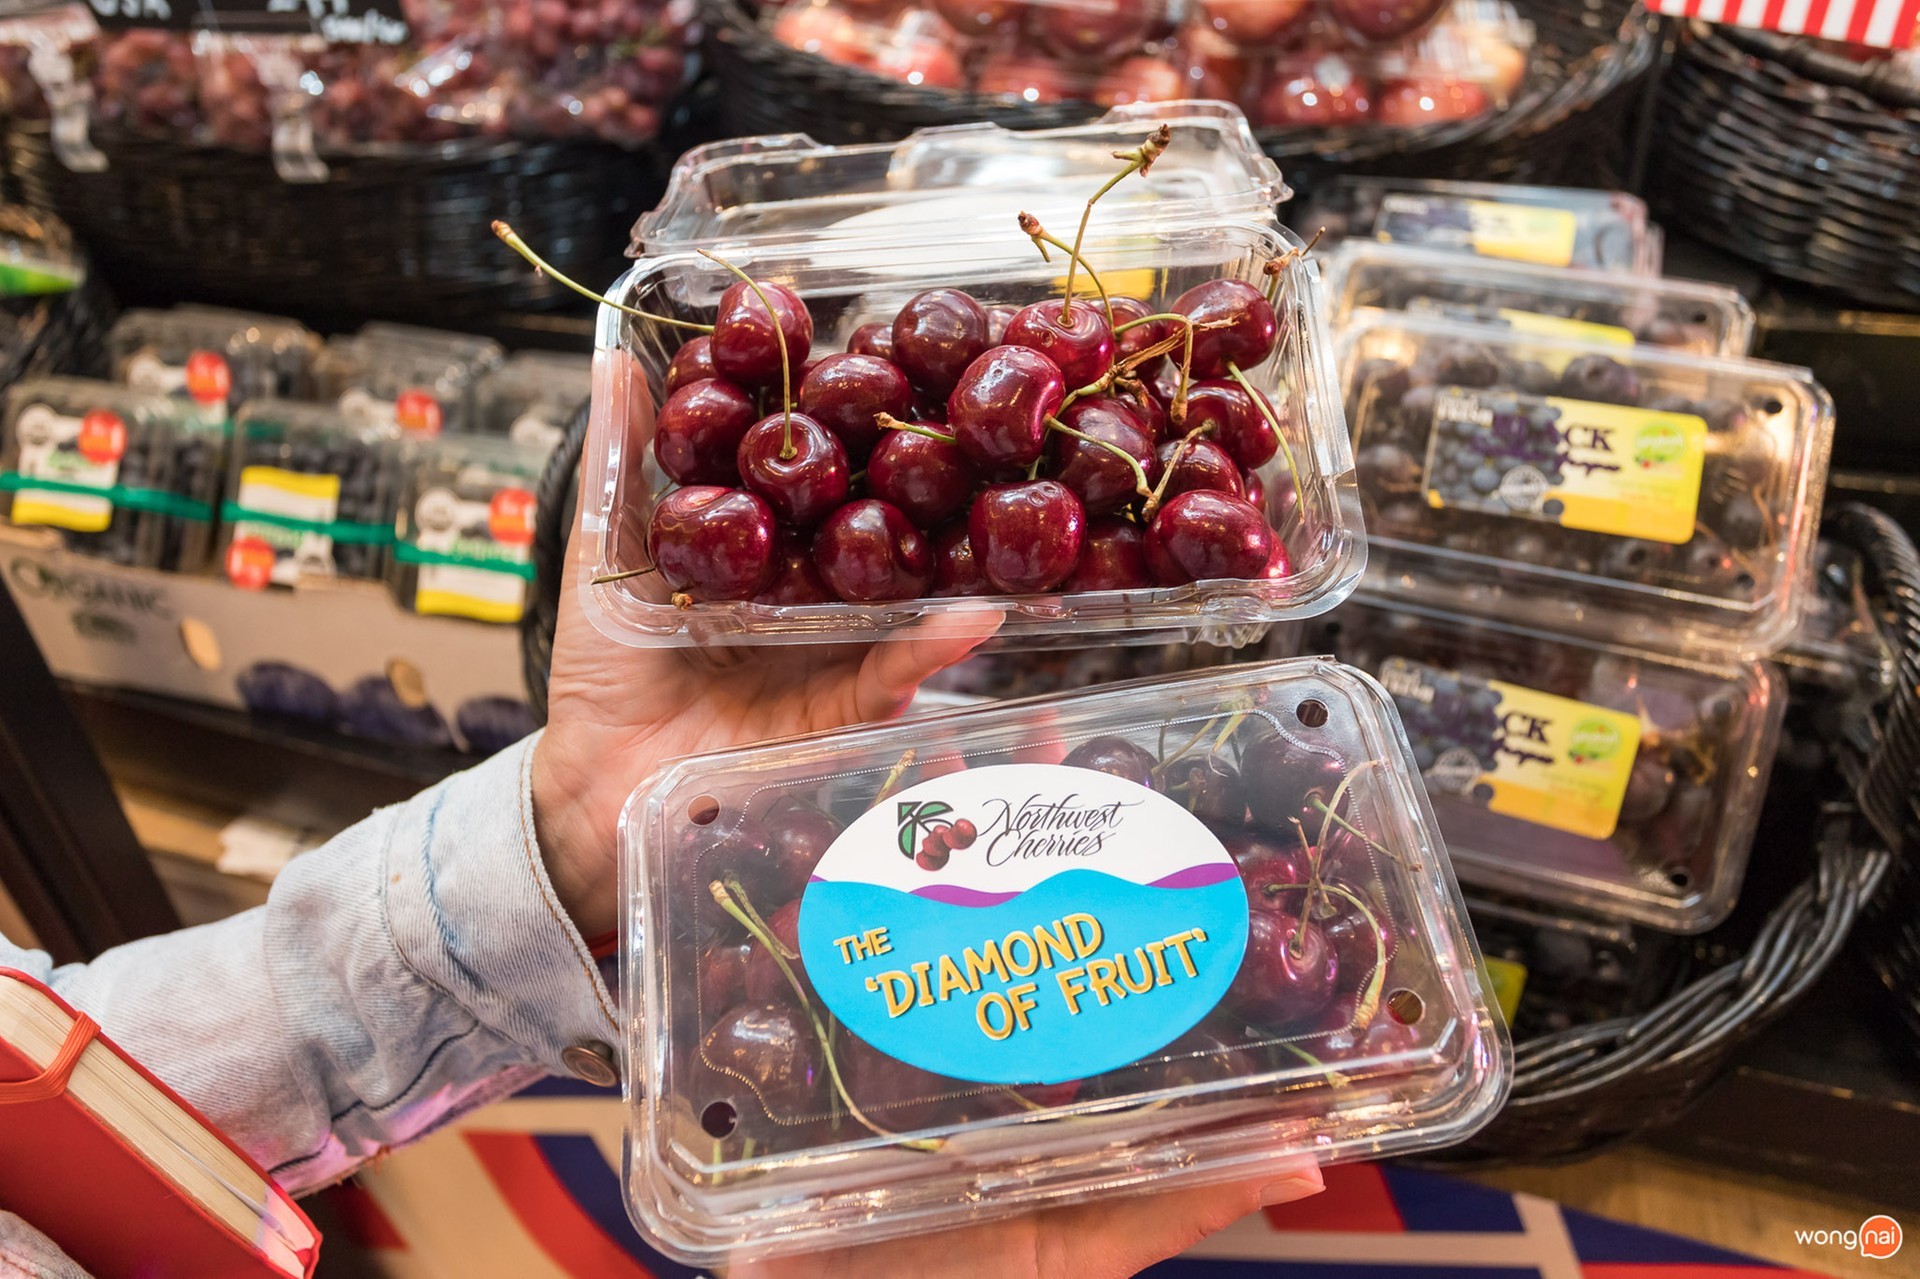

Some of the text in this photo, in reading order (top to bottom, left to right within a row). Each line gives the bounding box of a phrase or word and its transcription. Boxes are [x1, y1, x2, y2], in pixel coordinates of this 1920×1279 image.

[977, 793, 1145, 837] Northwest
[986, 829, 1116, 867] Cherries
[833, 926, 894, 965] THE
[865, 912, 1105, 1019] 'DIAMOND
[976, 927, 1207, 1041] OF FRUIT'
